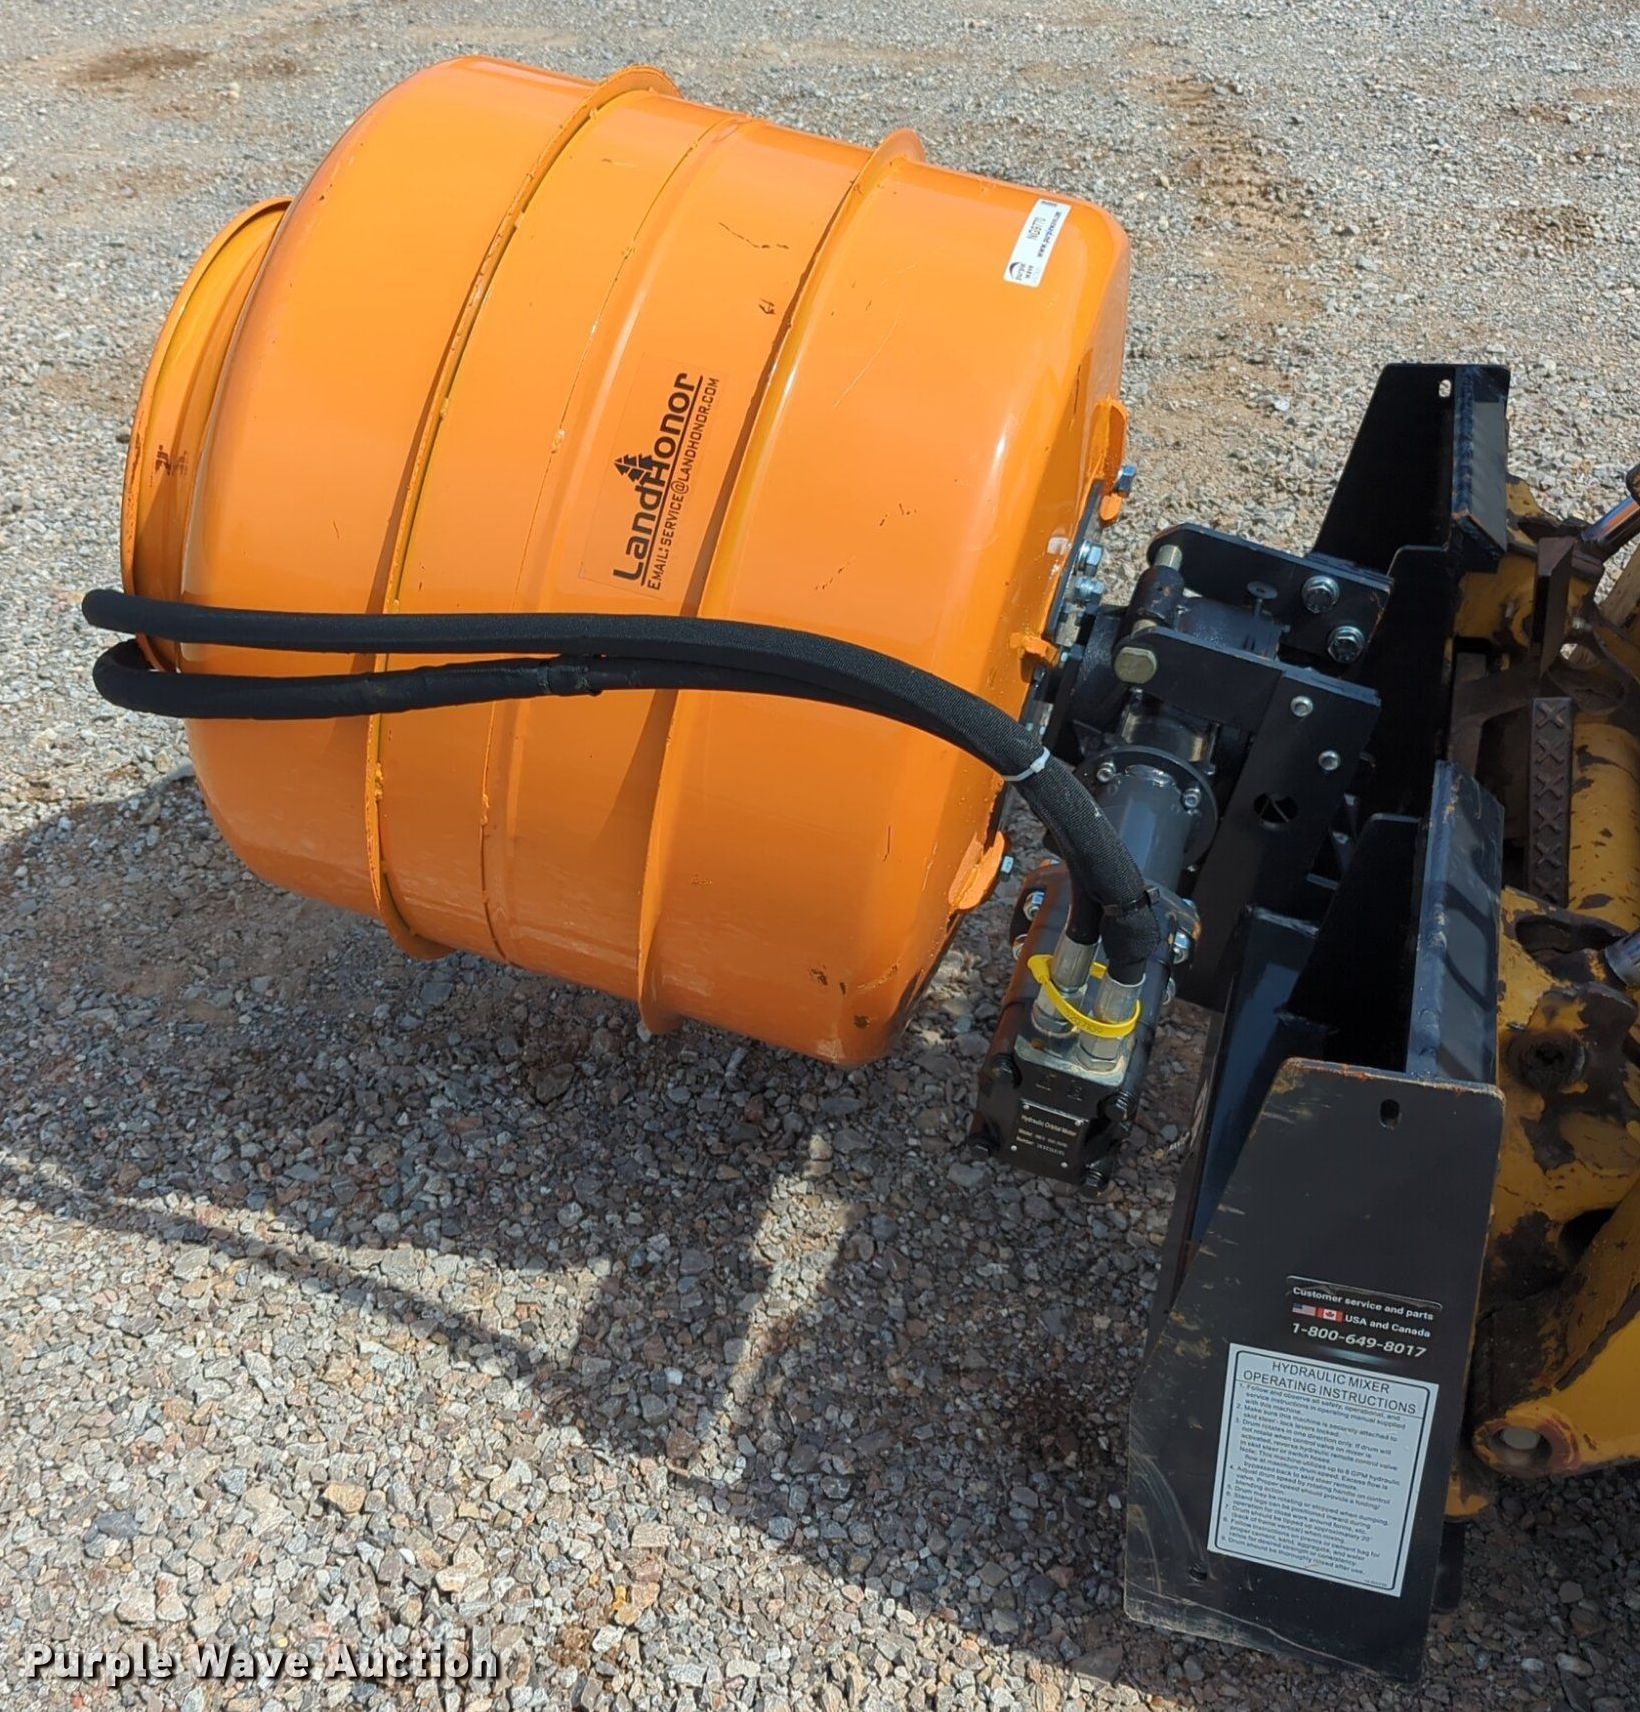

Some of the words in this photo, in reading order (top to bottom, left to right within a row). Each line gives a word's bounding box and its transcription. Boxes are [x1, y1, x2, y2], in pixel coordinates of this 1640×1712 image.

[613, 372, 696, 582] LandHonor
[1292, 1286, 1341, 1303] Customer
[1344, 1296, 1381, 1311] service
[1384, 1304, 1404, 1315] and
[1405, 1308, 1434, 1321] parts
[1291, 1322, 1427, 1358] 1-800-649-8017
[1344, 1314, 1367, 1325] USA
[1369, 1318, 1389, 1329] and
[1391, 1323, 1430, 1337] Canada
[1242, 1368, 1317, 1394] OPERATING
[1318, 1384, 1416, 1415] INSTRUCTIONS
[1271, 1360, 1346, 1385] HYDRAULIC
[1348, 1375, 1390, 1394] MIXER
